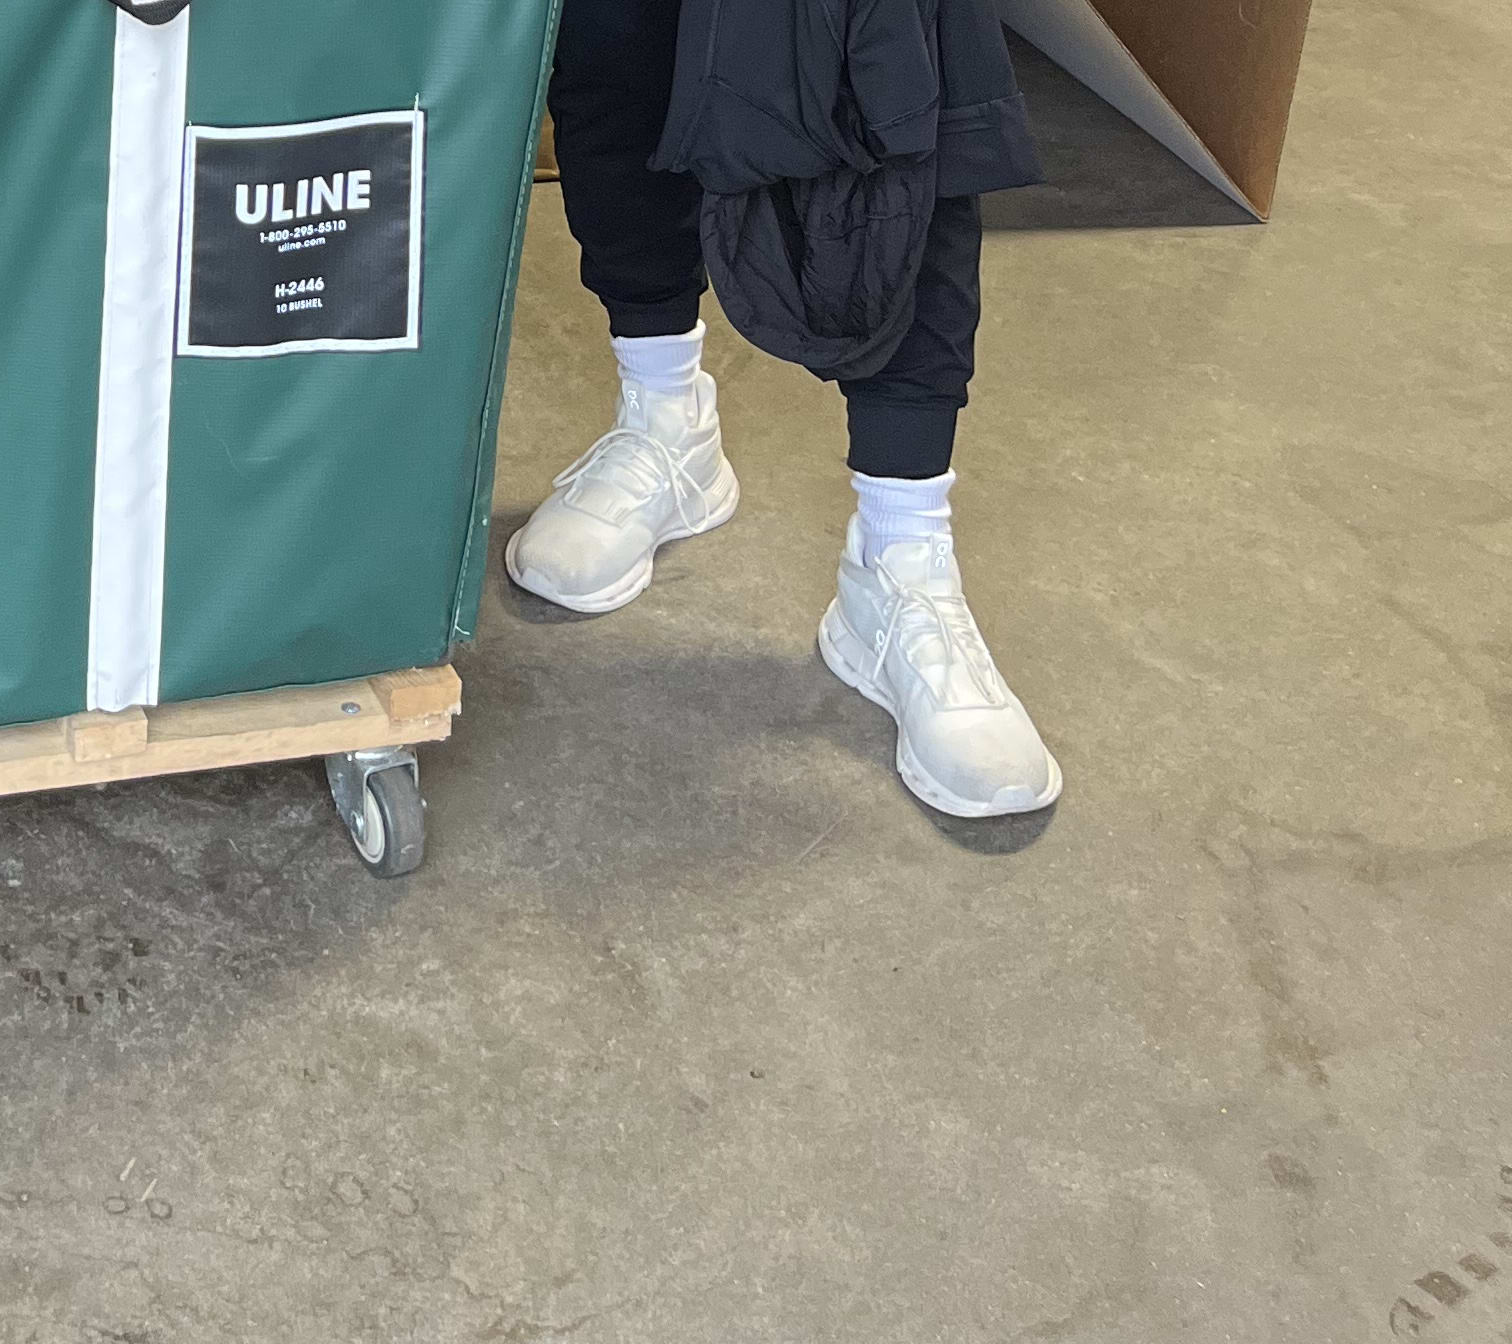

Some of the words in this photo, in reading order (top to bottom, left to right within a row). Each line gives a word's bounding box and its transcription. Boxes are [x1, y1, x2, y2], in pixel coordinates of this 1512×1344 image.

[234, 169, 372, 225] ULINE
[259, 219, 347, 243] 1-800-295-5510
[277, 236, 326, 253] uline.com
[274, 276, 325, 298] H-2446
[276, 303, 288, 314] 10
[288, 297, 323, 313] BUSHEL
